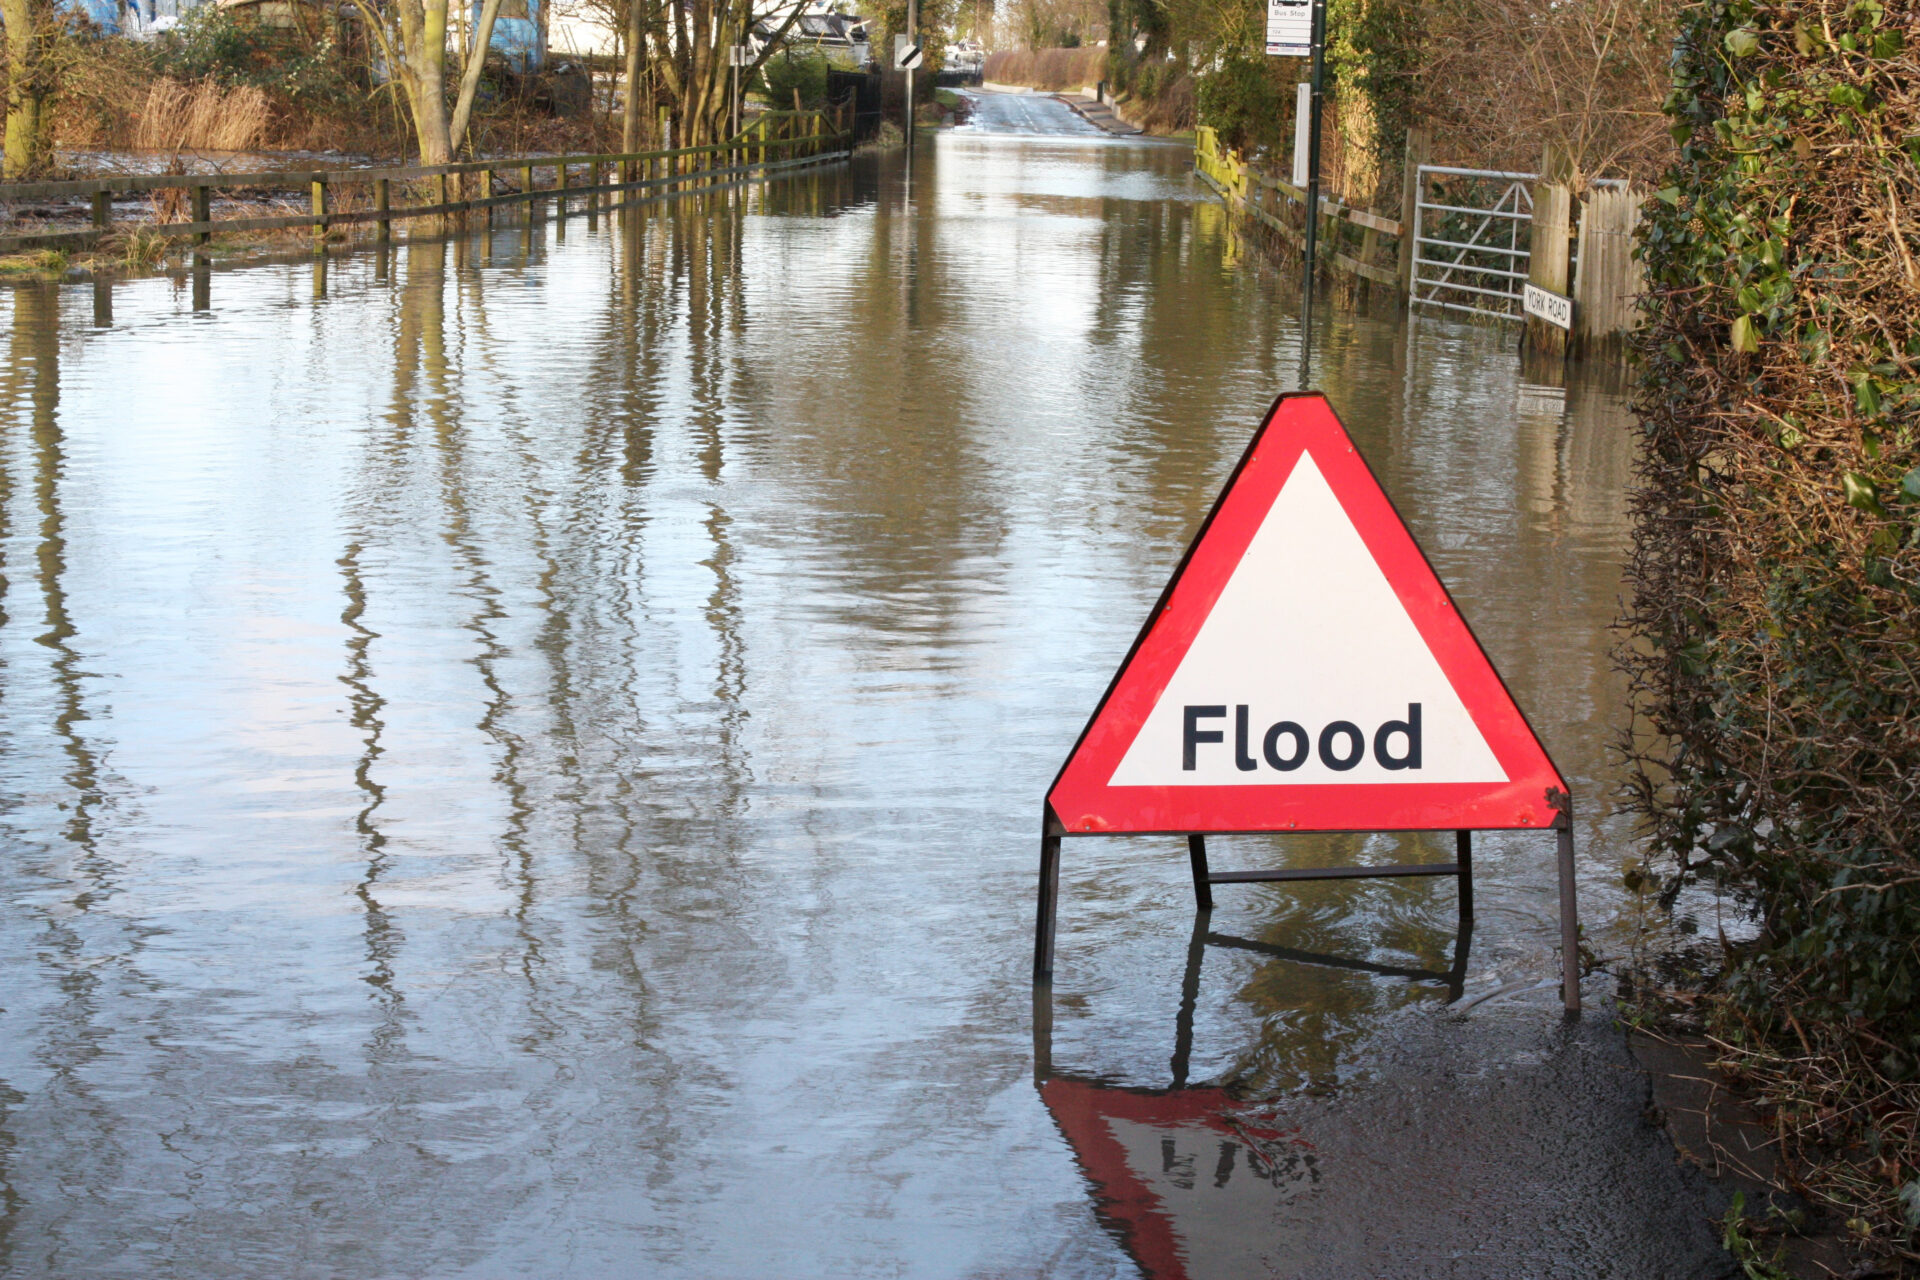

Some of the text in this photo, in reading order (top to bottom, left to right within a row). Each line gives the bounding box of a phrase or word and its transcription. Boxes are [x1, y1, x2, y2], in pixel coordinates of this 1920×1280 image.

[1527, 289, 1567, 321] YORK ROAD
[1182, 702, 1422, 772] Flood
